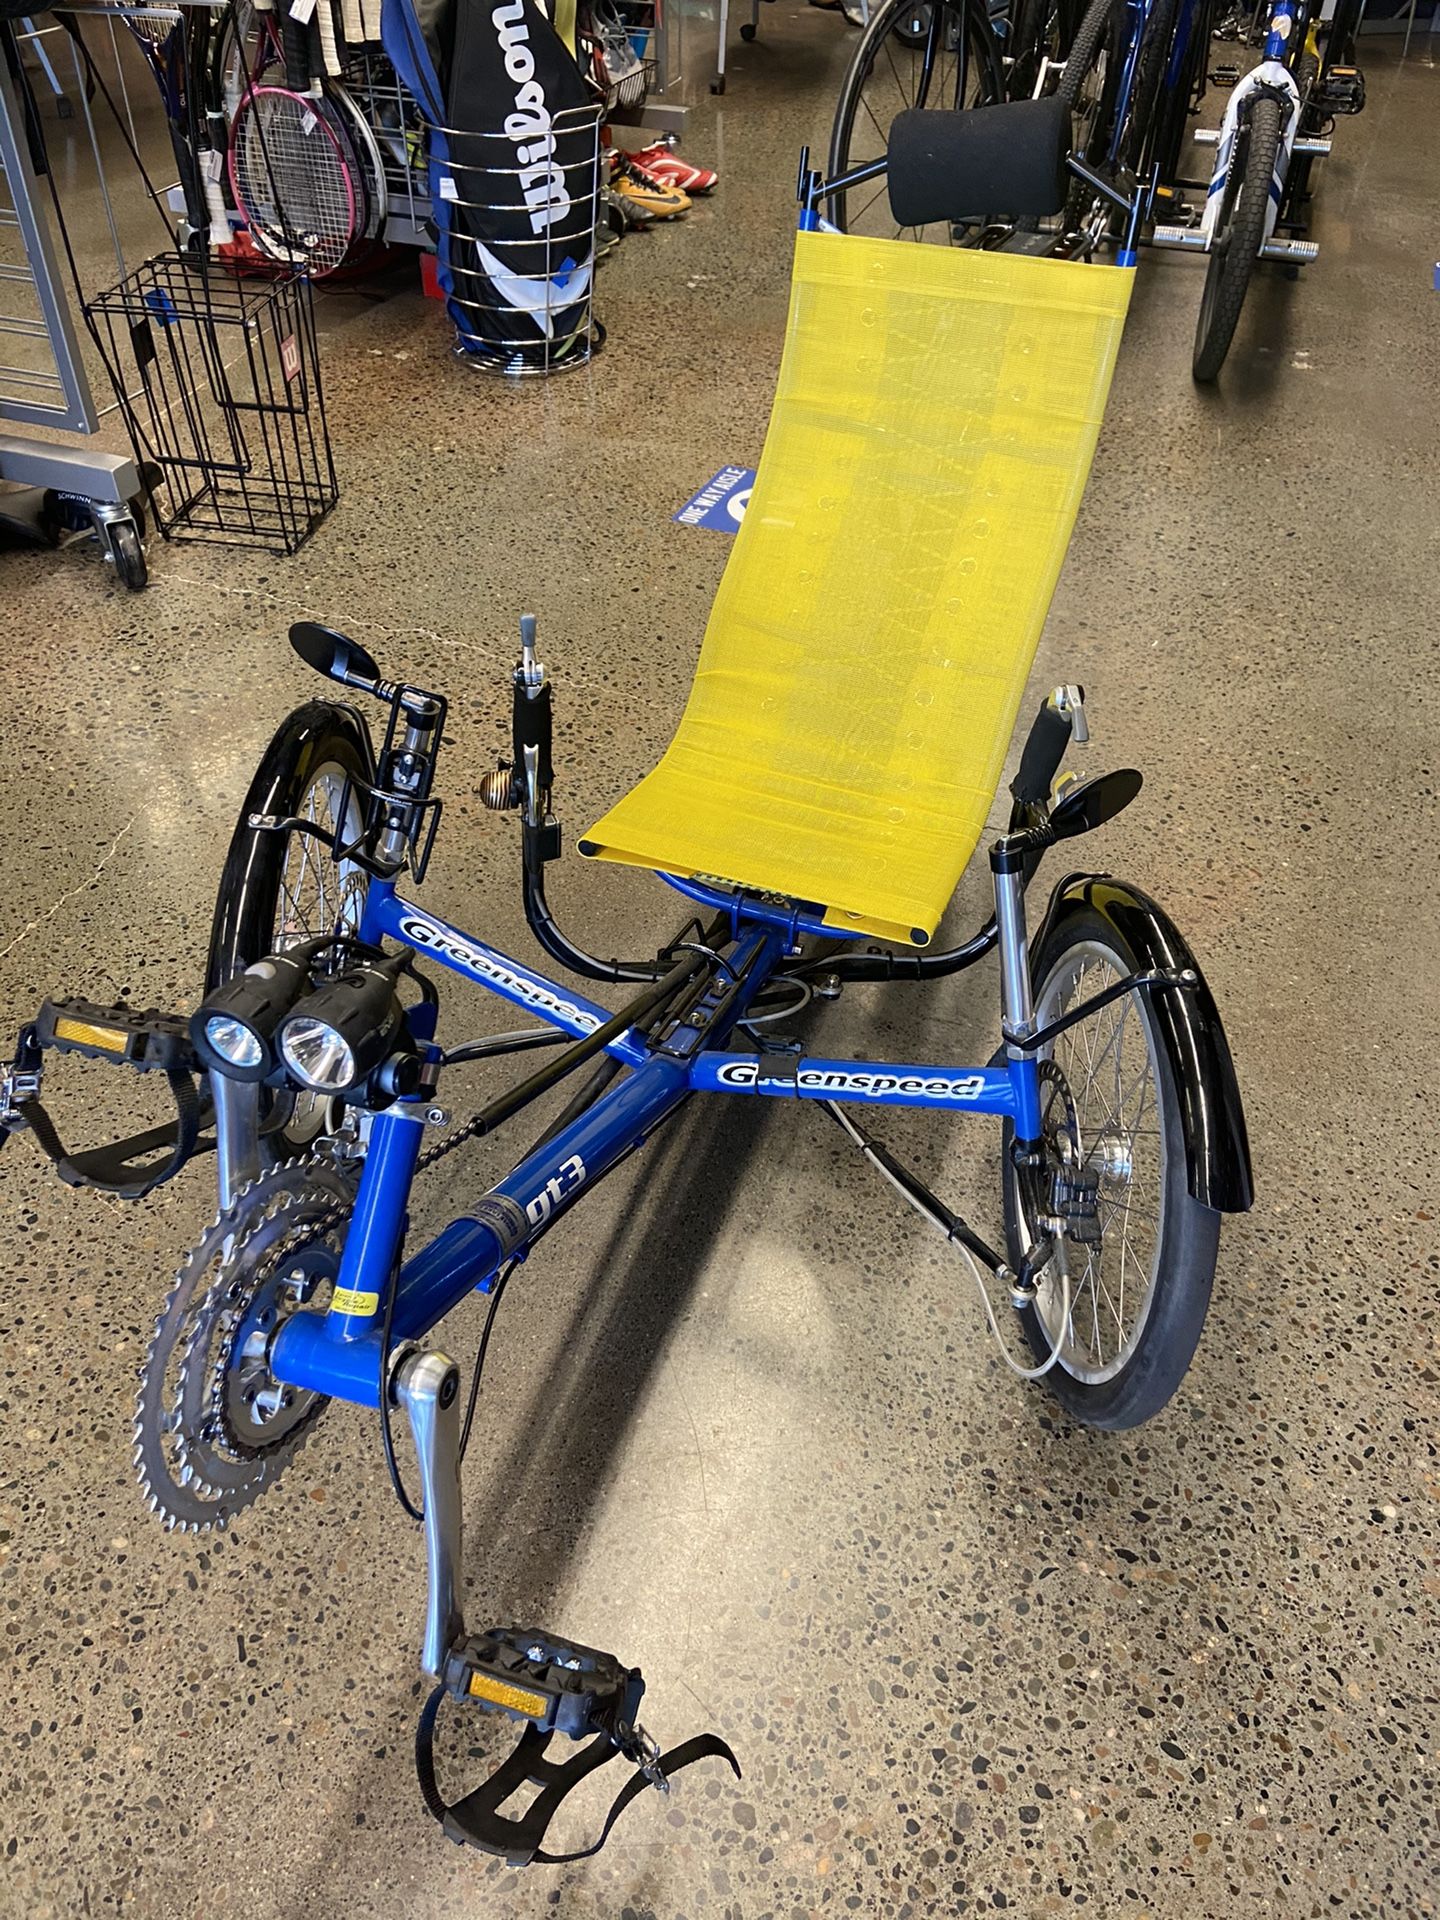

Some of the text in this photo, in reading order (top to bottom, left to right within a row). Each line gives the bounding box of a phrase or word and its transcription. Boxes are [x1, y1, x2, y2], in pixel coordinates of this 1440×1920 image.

[491, 0, 571, 235] Wilson
[57, 492, 92, 504] SCHWINN
[678, 467, 747, 524] ONE WAY AISLE
[400, 917, 605, 1034] Greenspee
[718, 1062, 984, 1098] Genspeed
[526, 1154, 587, 1232] gt3
